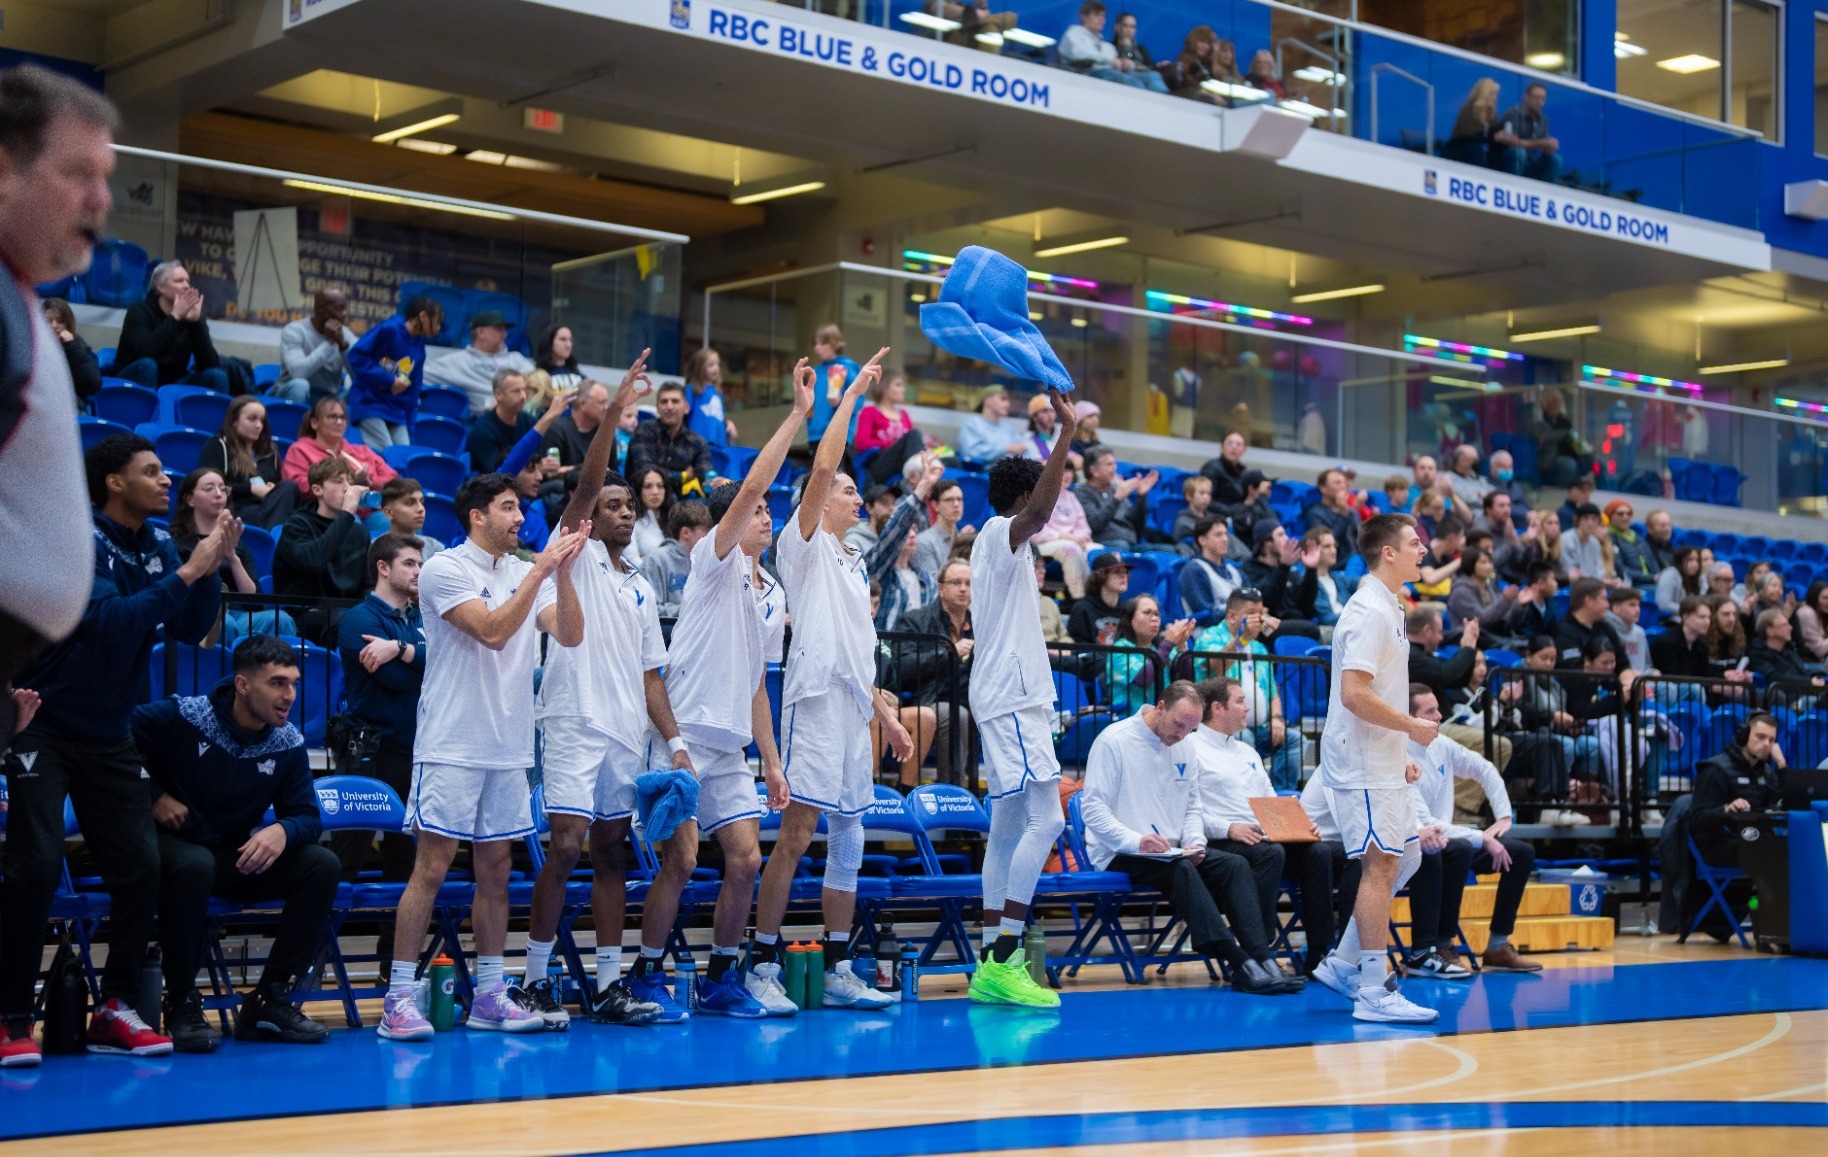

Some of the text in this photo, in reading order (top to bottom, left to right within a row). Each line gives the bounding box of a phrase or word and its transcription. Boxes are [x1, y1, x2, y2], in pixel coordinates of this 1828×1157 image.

[709, 9, 1050, 108] RBC BLUE & GOLD ROOM
[1449, 177, 1669, 243] RBC BLUE & GOLD ROOM
[201, 242, 222, 259] TO
[299, 240, 394, 265] PPORTUNITY
[341, 791, 389, 803] University
[873, 796, 902, 807] iversity
[937, 795, 972, 804] University
[343, 801, 392, 812] of Victoria
[876, 805, 905, 815] Victoria
[940, 803, 976, 812] of Victoria
